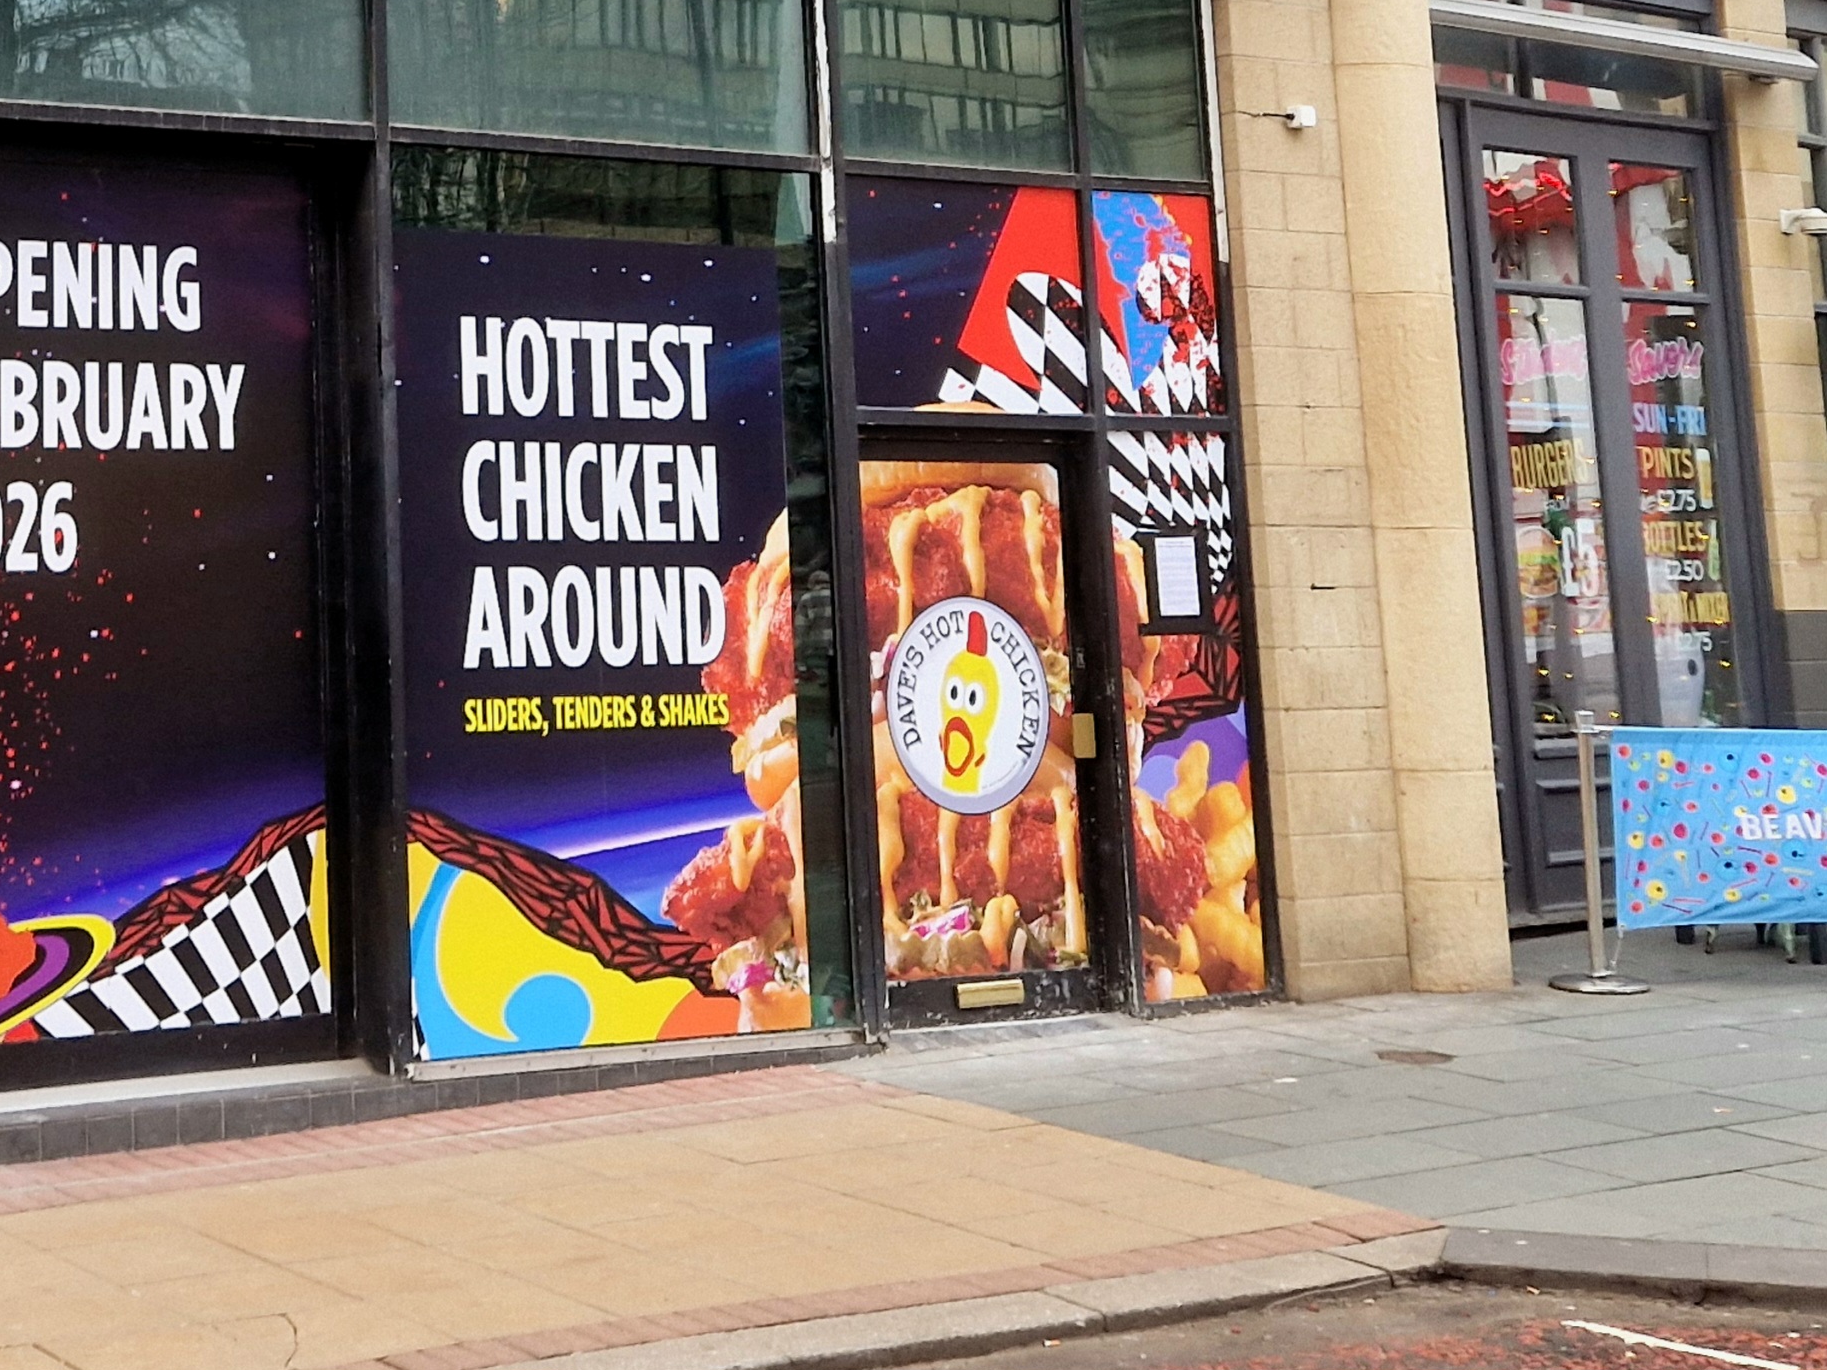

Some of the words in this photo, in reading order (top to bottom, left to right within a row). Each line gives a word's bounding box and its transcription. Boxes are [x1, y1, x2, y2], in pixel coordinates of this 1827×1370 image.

[458, 315, 714, 421] HOTTEST
[461, 440, 720, 543] CHICKEN
[1510, 438, 1589, 489] BURGERS
[1640, 446, 1696, 480] PINTS
[462, 565, 727, 669] AROUND
[464, 696, 549, 737] SLIDERS,
[552, 695, 637, 730] TENDERS
[640, 694, 656, 728] &
[658, 693, 730, 727] SHAKES
[895, 646, 925, 751] DAVE'S
[924, 610, 965, 651] HOT
[990, 621, 1041, 761] CHICKEN
